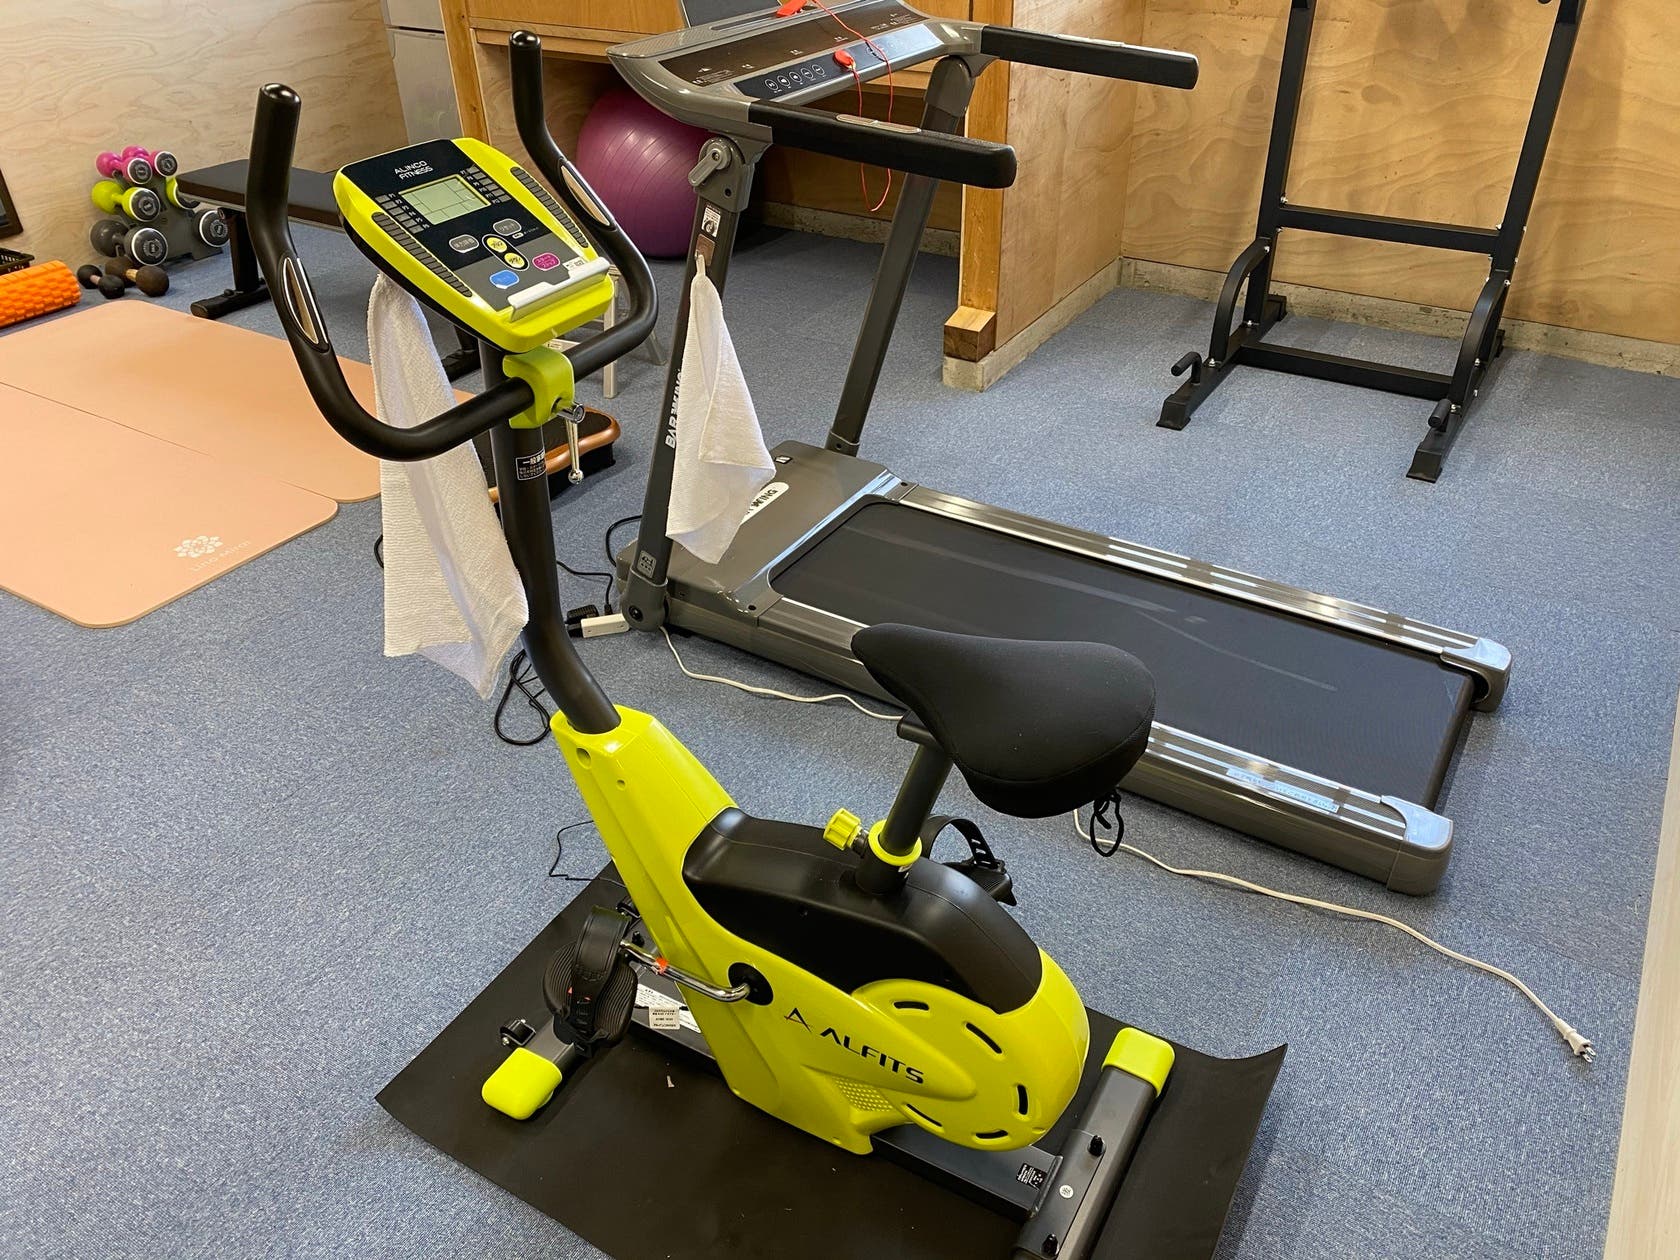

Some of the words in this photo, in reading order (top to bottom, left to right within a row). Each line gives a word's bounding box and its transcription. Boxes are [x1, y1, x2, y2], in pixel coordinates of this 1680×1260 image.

[394, 160, 427, 175] ALINCO
[399, 165, 433, 180] FITNESS
[820, 1027, 924, 1084] ALFITS
